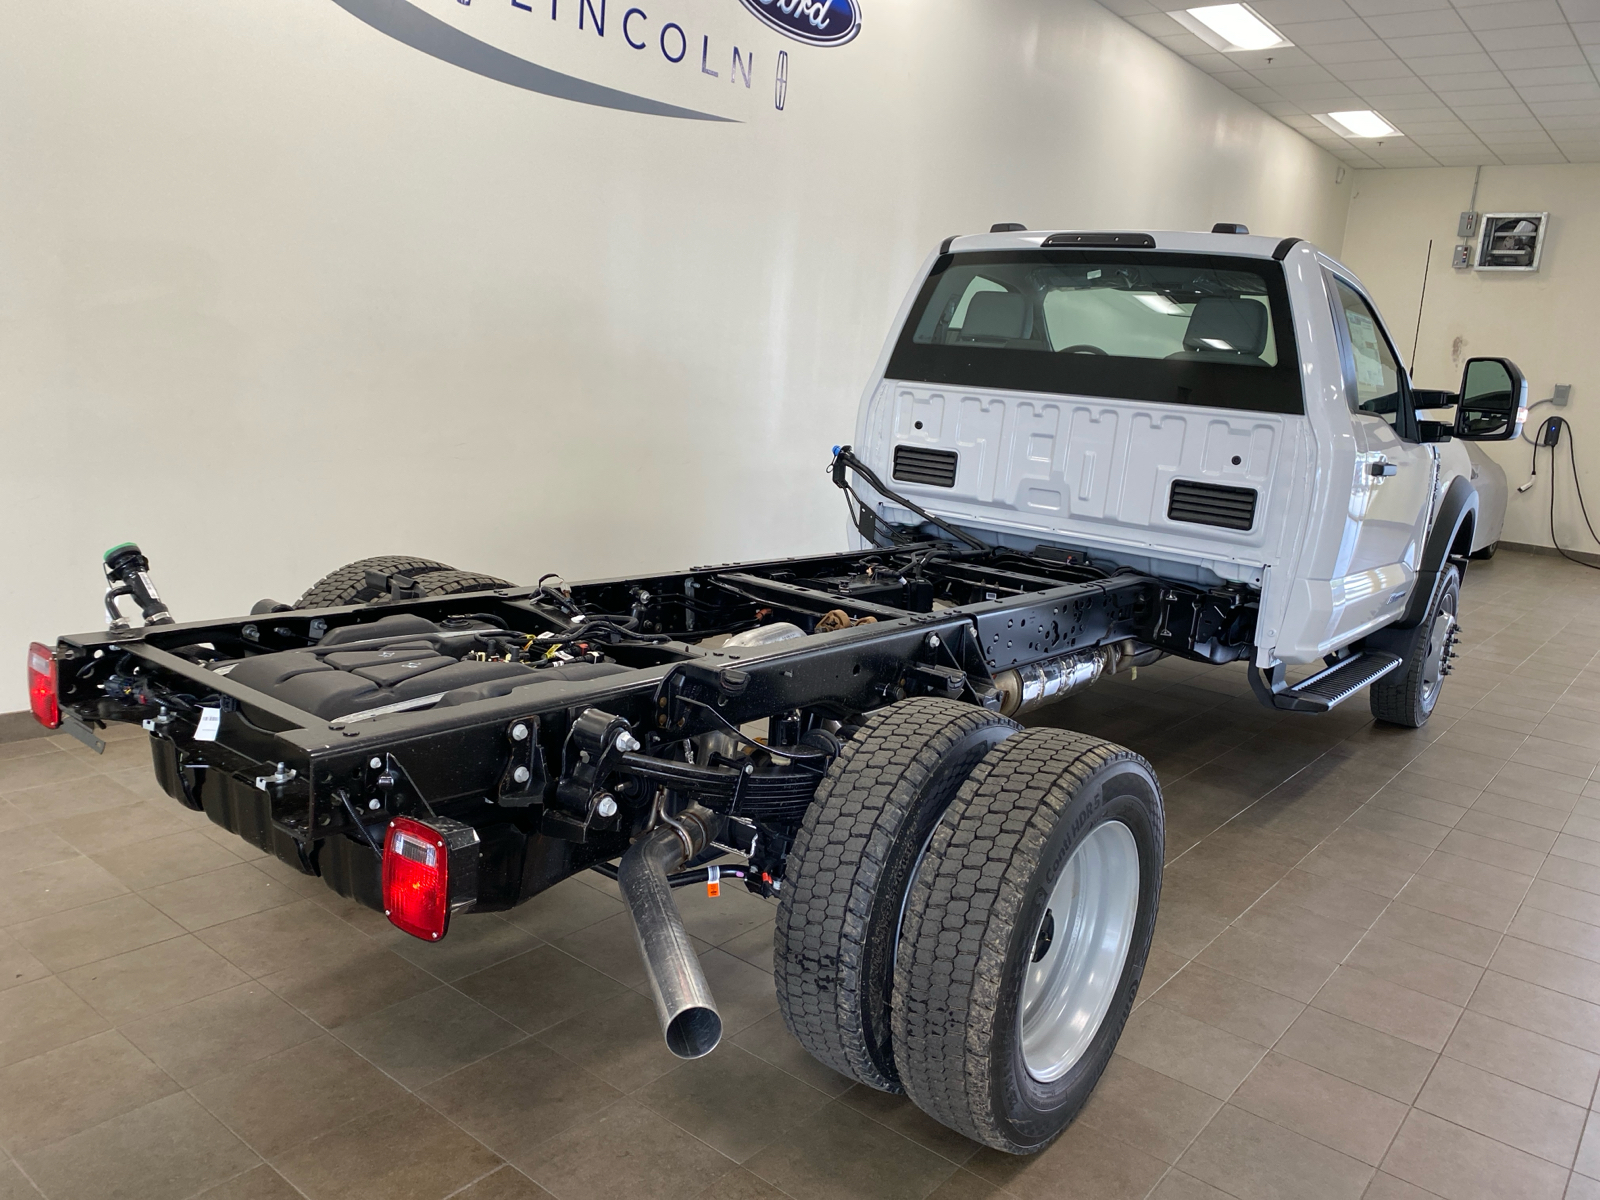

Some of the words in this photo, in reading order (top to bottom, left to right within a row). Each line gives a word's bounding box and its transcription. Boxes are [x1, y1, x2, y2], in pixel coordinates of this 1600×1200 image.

[511, 0, 753, 89] NCOLN
[760, 0, 830, 29] ord
[1045, 831, 1073, 885] Conti
[1070, 801, 1093, 838] HDR
